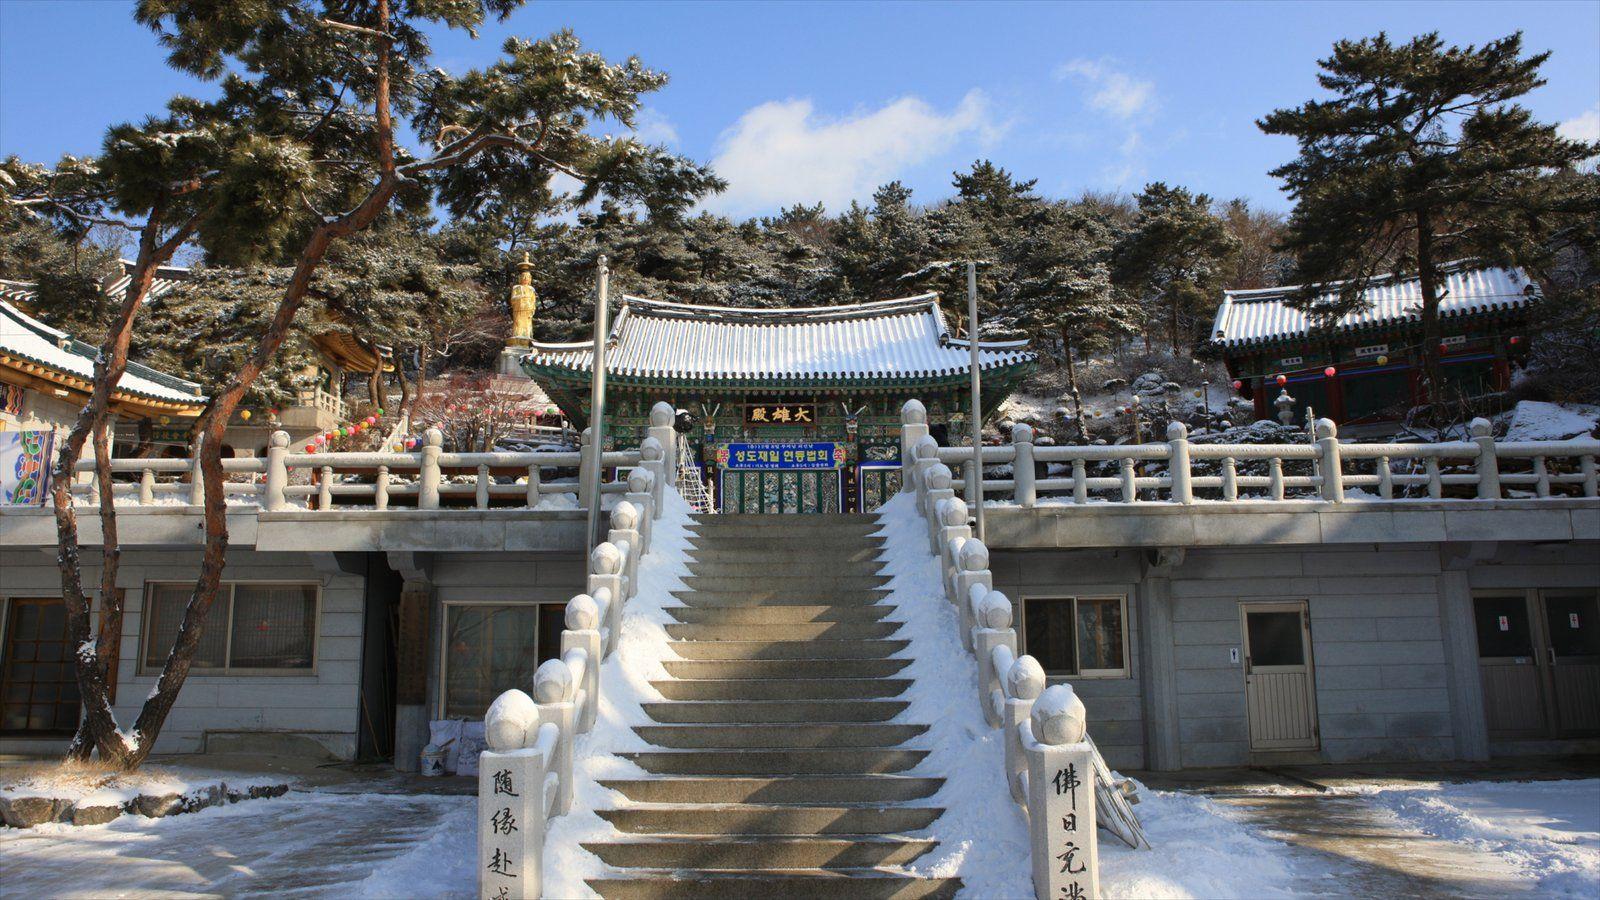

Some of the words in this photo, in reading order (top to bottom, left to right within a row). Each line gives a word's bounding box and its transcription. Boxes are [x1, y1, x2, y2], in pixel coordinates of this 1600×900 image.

[751, 406, 812, 423] 大雄殿
[735, 450, 780, 462] 성도재일
[783, 450, 828, 462] 연등법회
